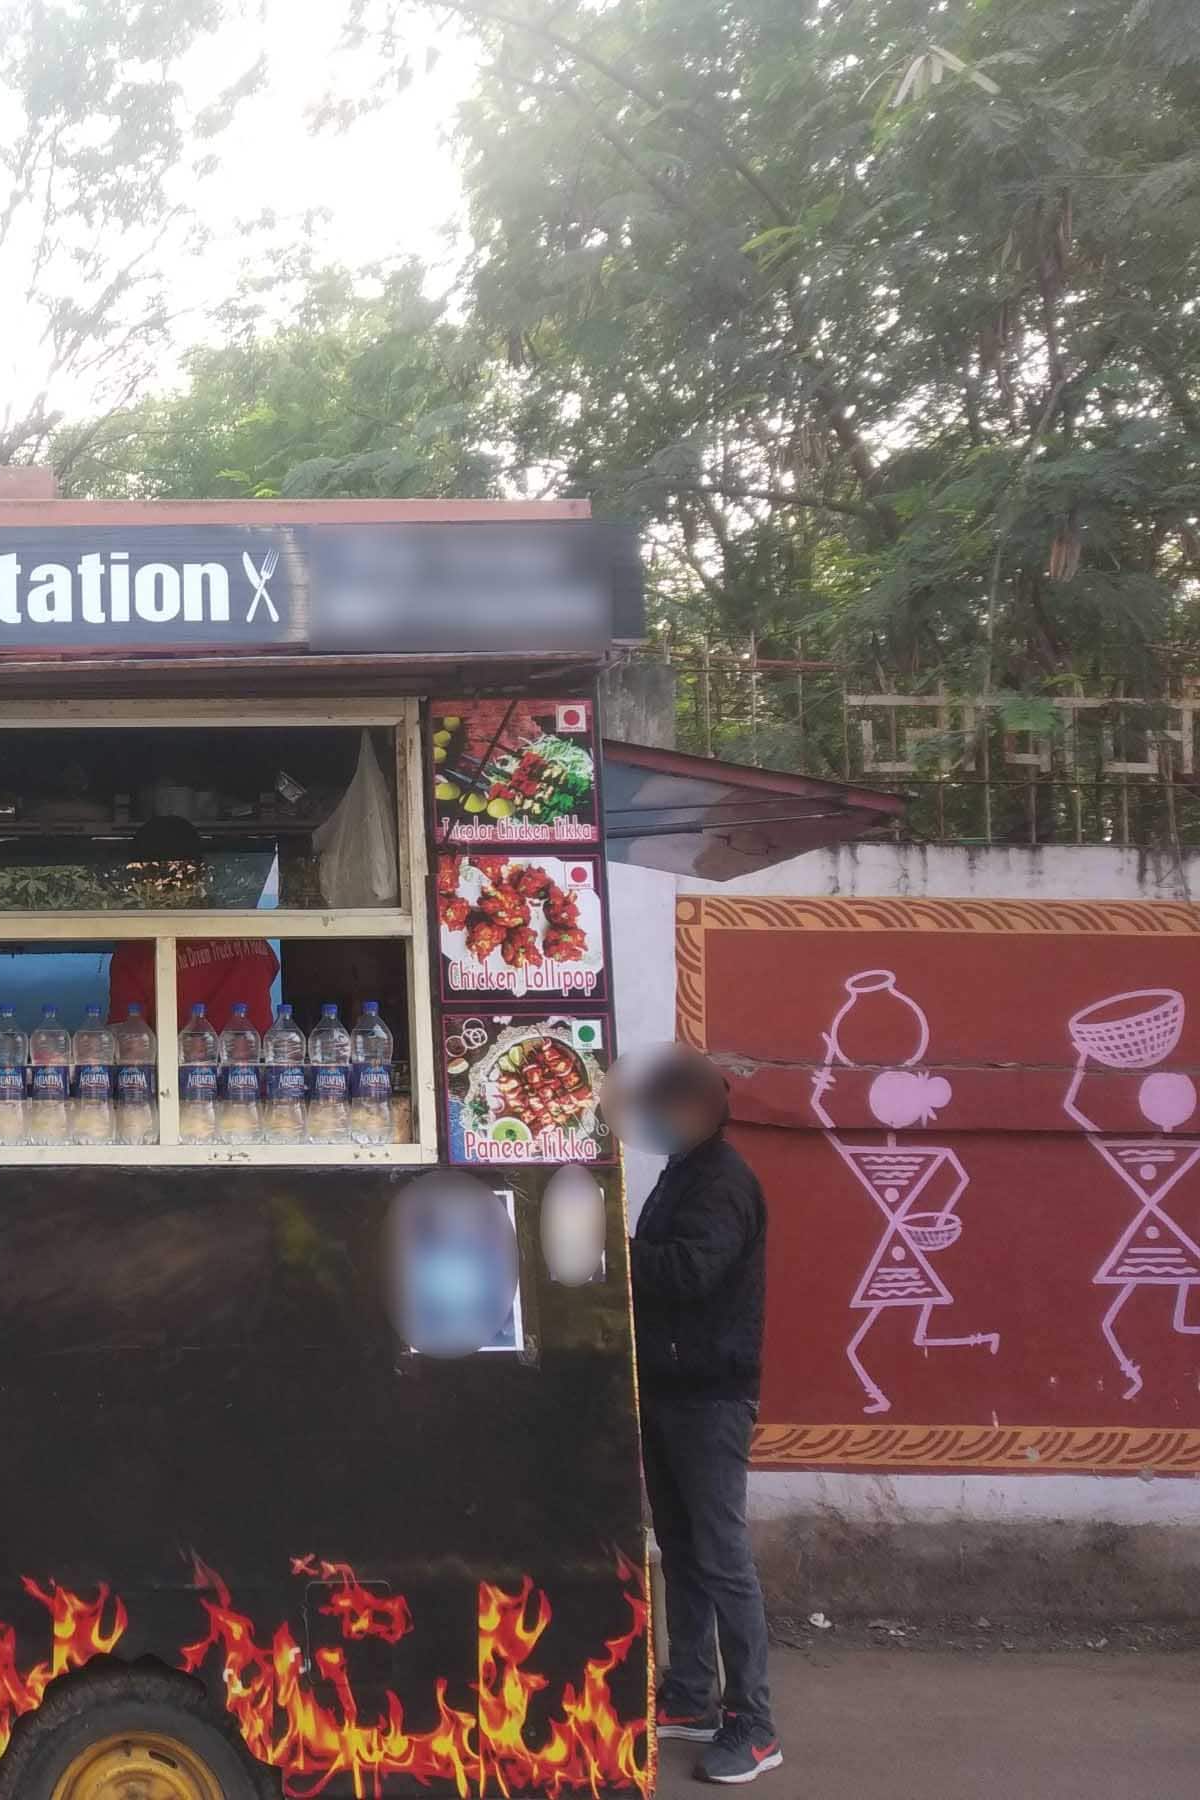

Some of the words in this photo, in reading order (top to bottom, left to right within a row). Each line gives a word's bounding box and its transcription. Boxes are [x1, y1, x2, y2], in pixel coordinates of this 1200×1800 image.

[441, 816, 493, 841] Ticolor
[497, 815, 550, 841] Chicken
[553, 815, 593, 840] Tikka
[449, 960, 517, 990] Chicken
[523, 960, 597, 996] Lollipop
[464, 1130, 532, 1159] Paneer
[541, 1128, 597, 1159] Tikka
